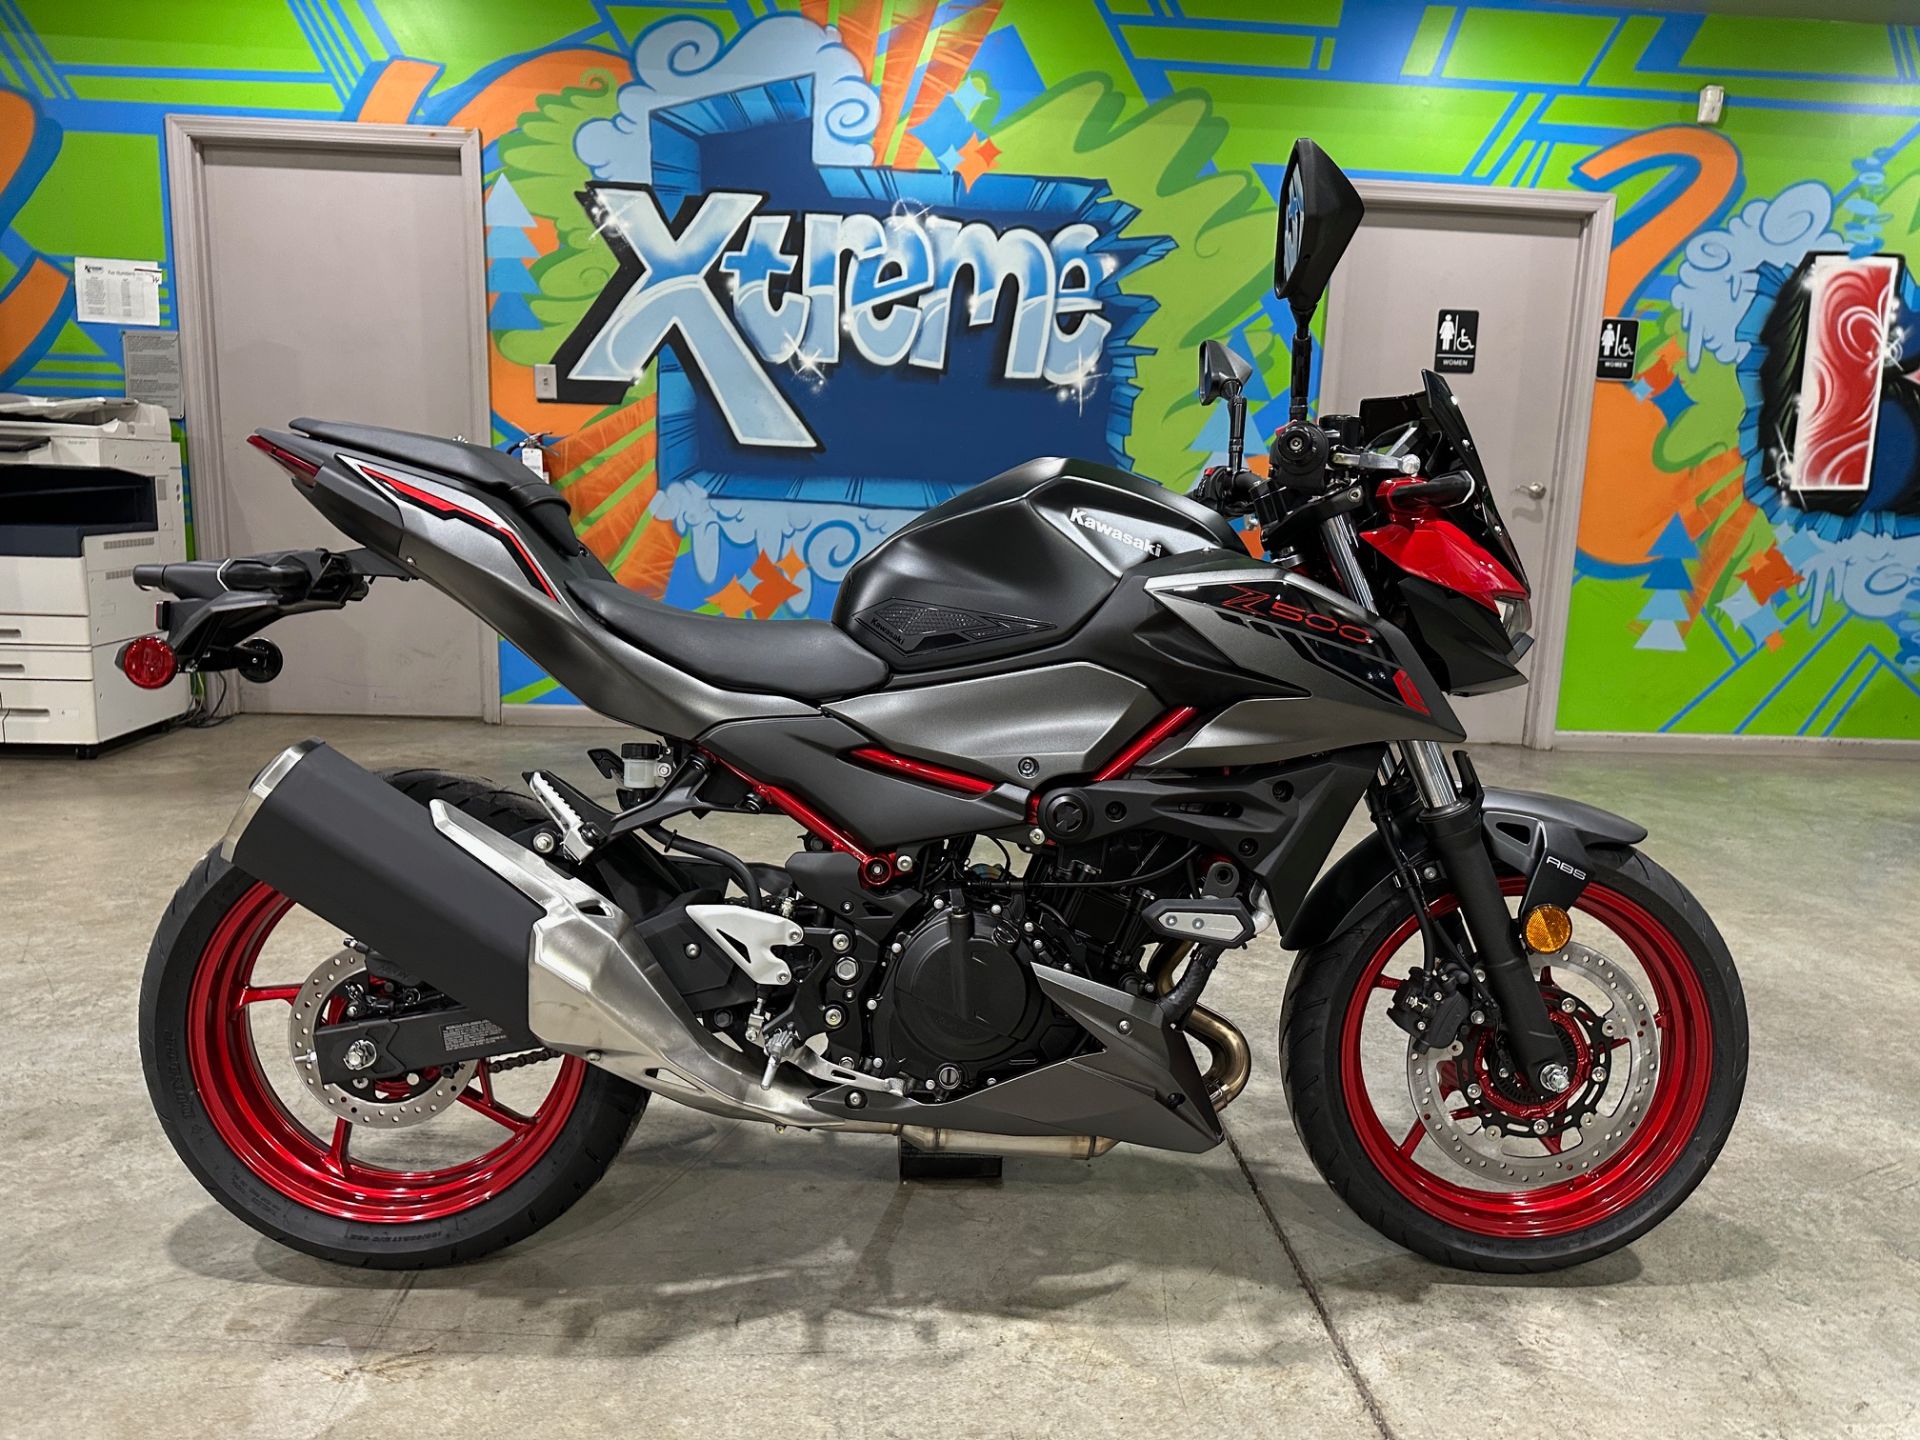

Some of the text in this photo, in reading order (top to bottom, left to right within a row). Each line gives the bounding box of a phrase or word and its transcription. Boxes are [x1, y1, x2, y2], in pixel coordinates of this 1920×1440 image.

[565, 188, 1113, 449] Xtreme
[1069, 507, 1162, 558] Kawasaki
[870, 617, 905, 645] Kawasaki
[1546, 856, 1587, 880] ABS
